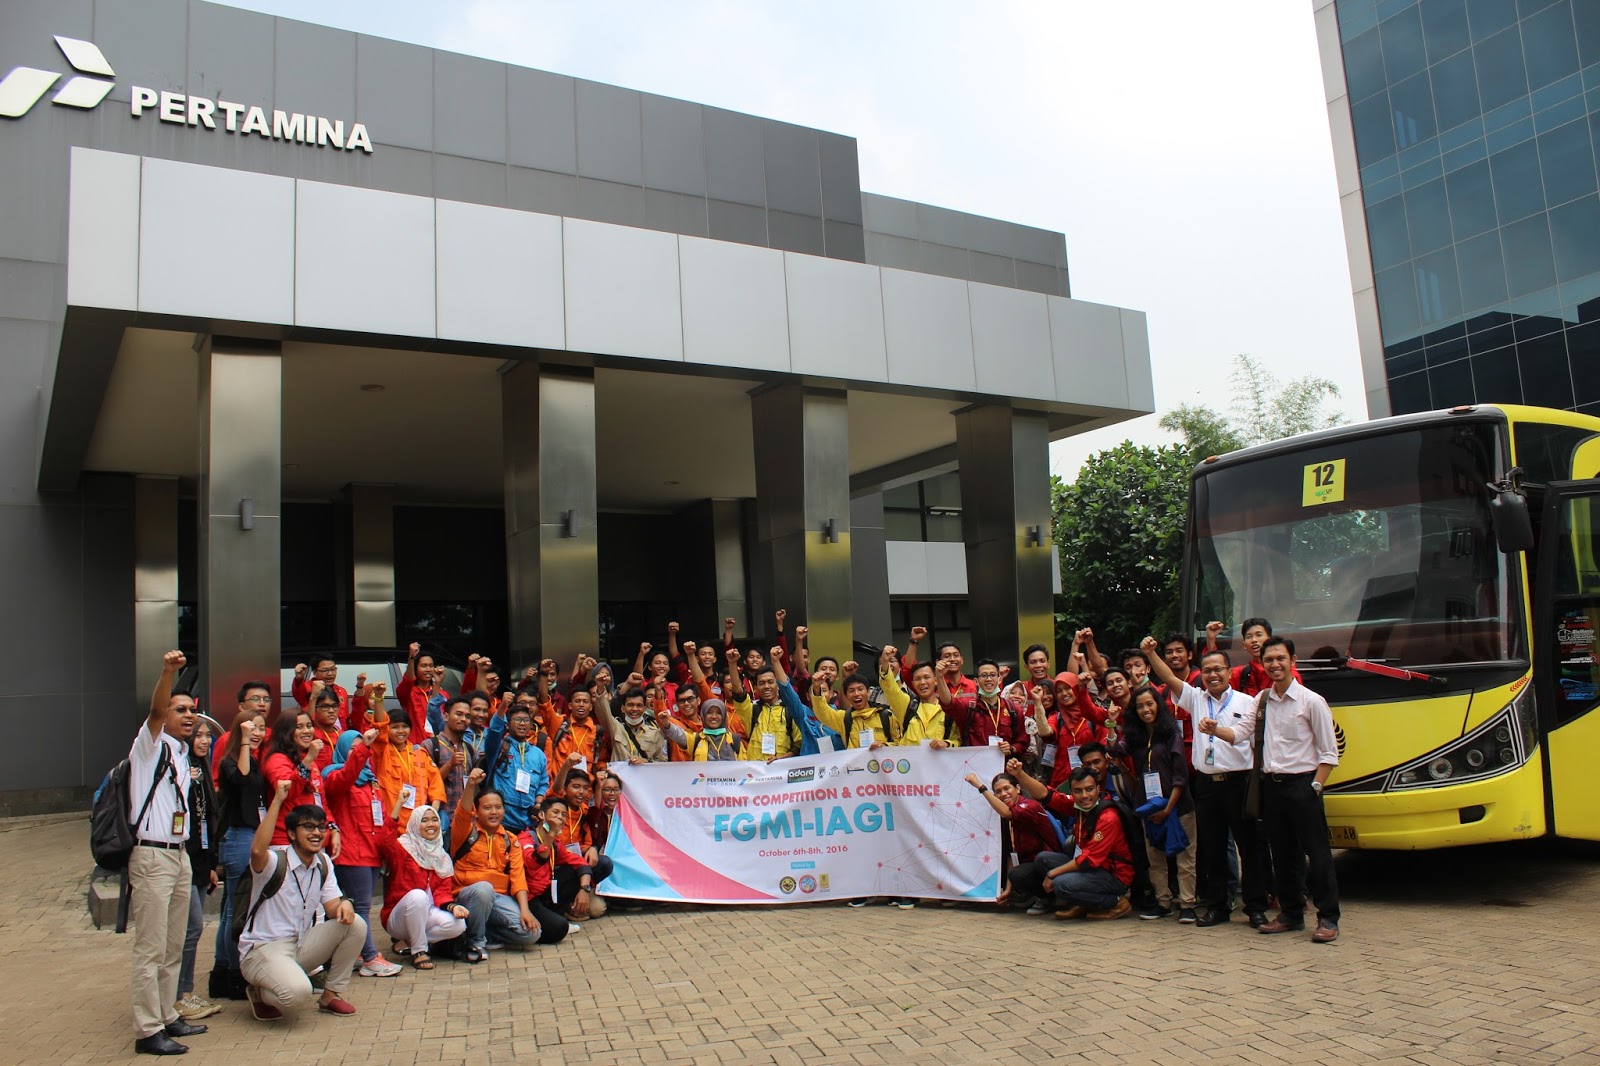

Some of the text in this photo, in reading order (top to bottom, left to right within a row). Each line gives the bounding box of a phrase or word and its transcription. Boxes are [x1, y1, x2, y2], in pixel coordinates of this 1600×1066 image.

[131, 85, 373, 153] PERTAMINA
[1312, 463, 1335, 487] 12
[788, 769, 814, 777] adaro
[664, 784, 941, 809] GEOSTUDENT COMPETITION & CONFERENCE
[713, 802, 895, 842] FGMI-IAGI
[759, 845, 848, 857] October 6th-8th, 2016
